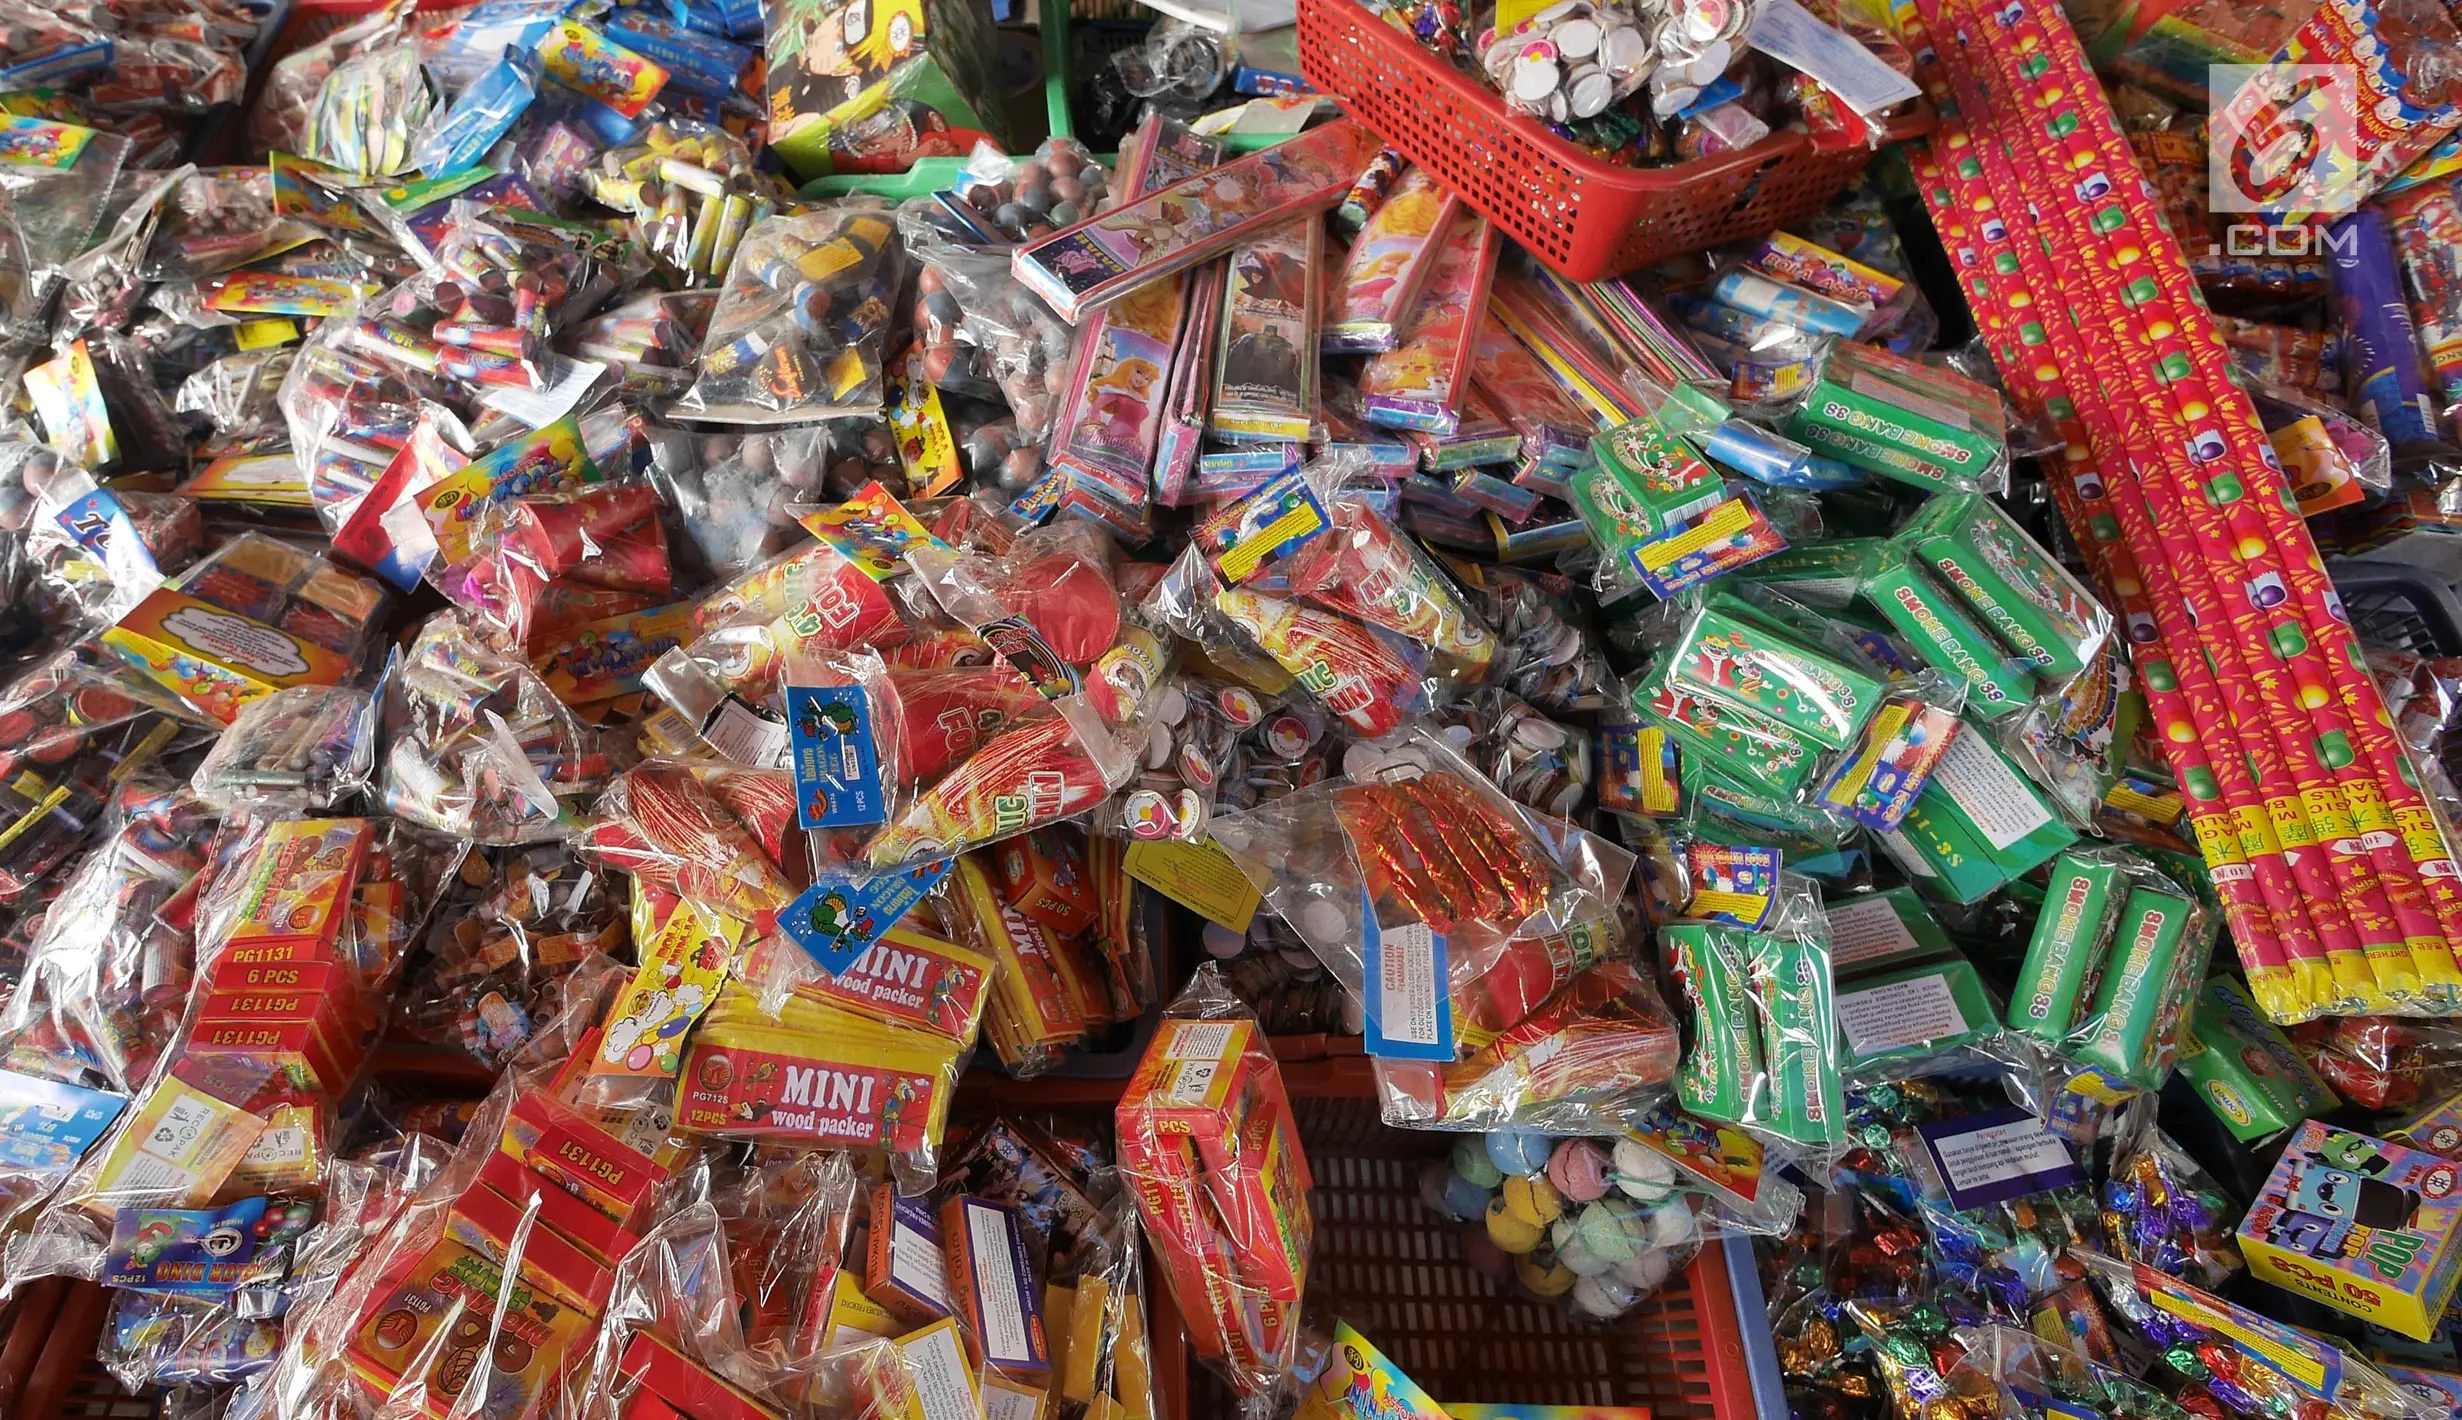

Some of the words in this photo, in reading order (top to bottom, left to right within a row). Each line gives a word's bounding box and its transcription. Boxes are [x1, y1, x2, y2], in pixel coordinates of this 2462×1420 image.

[1845, 408, 1905, 441] BANG
[1826, 429, 1883, 459] BANG
[1899, 428, 1973, 465] SMOKE
[1878, 448, 1947, 481] SMOKE
[1936, 550, 1996, 616] SMOKE
[1985, 599, 2036, 654] BANG
[2025, 640, 2055, 671] 38
[1893, 581, 1951, 646] SMOKE
[1939, 633, 1988, 688] BANG
[868, 874, 907, 911] DRAGON
[2054, 874, 2091, 944] SMOKE
[232, 946, 294, 963] PG1131
[654, 913, 686, 961] BOLA
[2124, 907, 2164, 979] SMOKE
[247, 968, 260, 983] 6
[262, 968, 299, 984] PCS
[1383, 943, 1395, 991] CAUTION
[1395, 945, 1405, 992] FLAMMABLE
[2035, 938, 2069, 995] BANG
[230, 998, 299, 1011] PG1131
[873, 984, 924, 1010] packer
[2027, 992, 2052, 1020] 38
[2104, 972, 2140, 1031] BANG
[212, 1030, 281, 1046] PG1131
[1734, 1028, 1754, 1102] SMOKE
[780, 1065, 875, 1114] MINI
[1801, 1049, 1821, 1121] SMOKE
[690, 1108, 728, 1126] 12PCS
[771, 1108, 815, 1131] wood
[817, 1114, 875, 1140] packer
[1158, 1119, 1191, 1134] PCS
[557, 1140, 626, 1185] PG1131
[947, 1231, 965, 1280] Cobra
[2341, 1223, 2371, 1258] POP
[2363, 1228, 2427, 1281] POP
[112, 1274, 146, 1283] 12PCS
[155, 1262, 203, 1282] DINO
[2268, 1255, 2336, 1290] PCS
[2294, 1279, 2372, 1313] CONTENTS
[2343, 1282, 2382, 1307] 50
